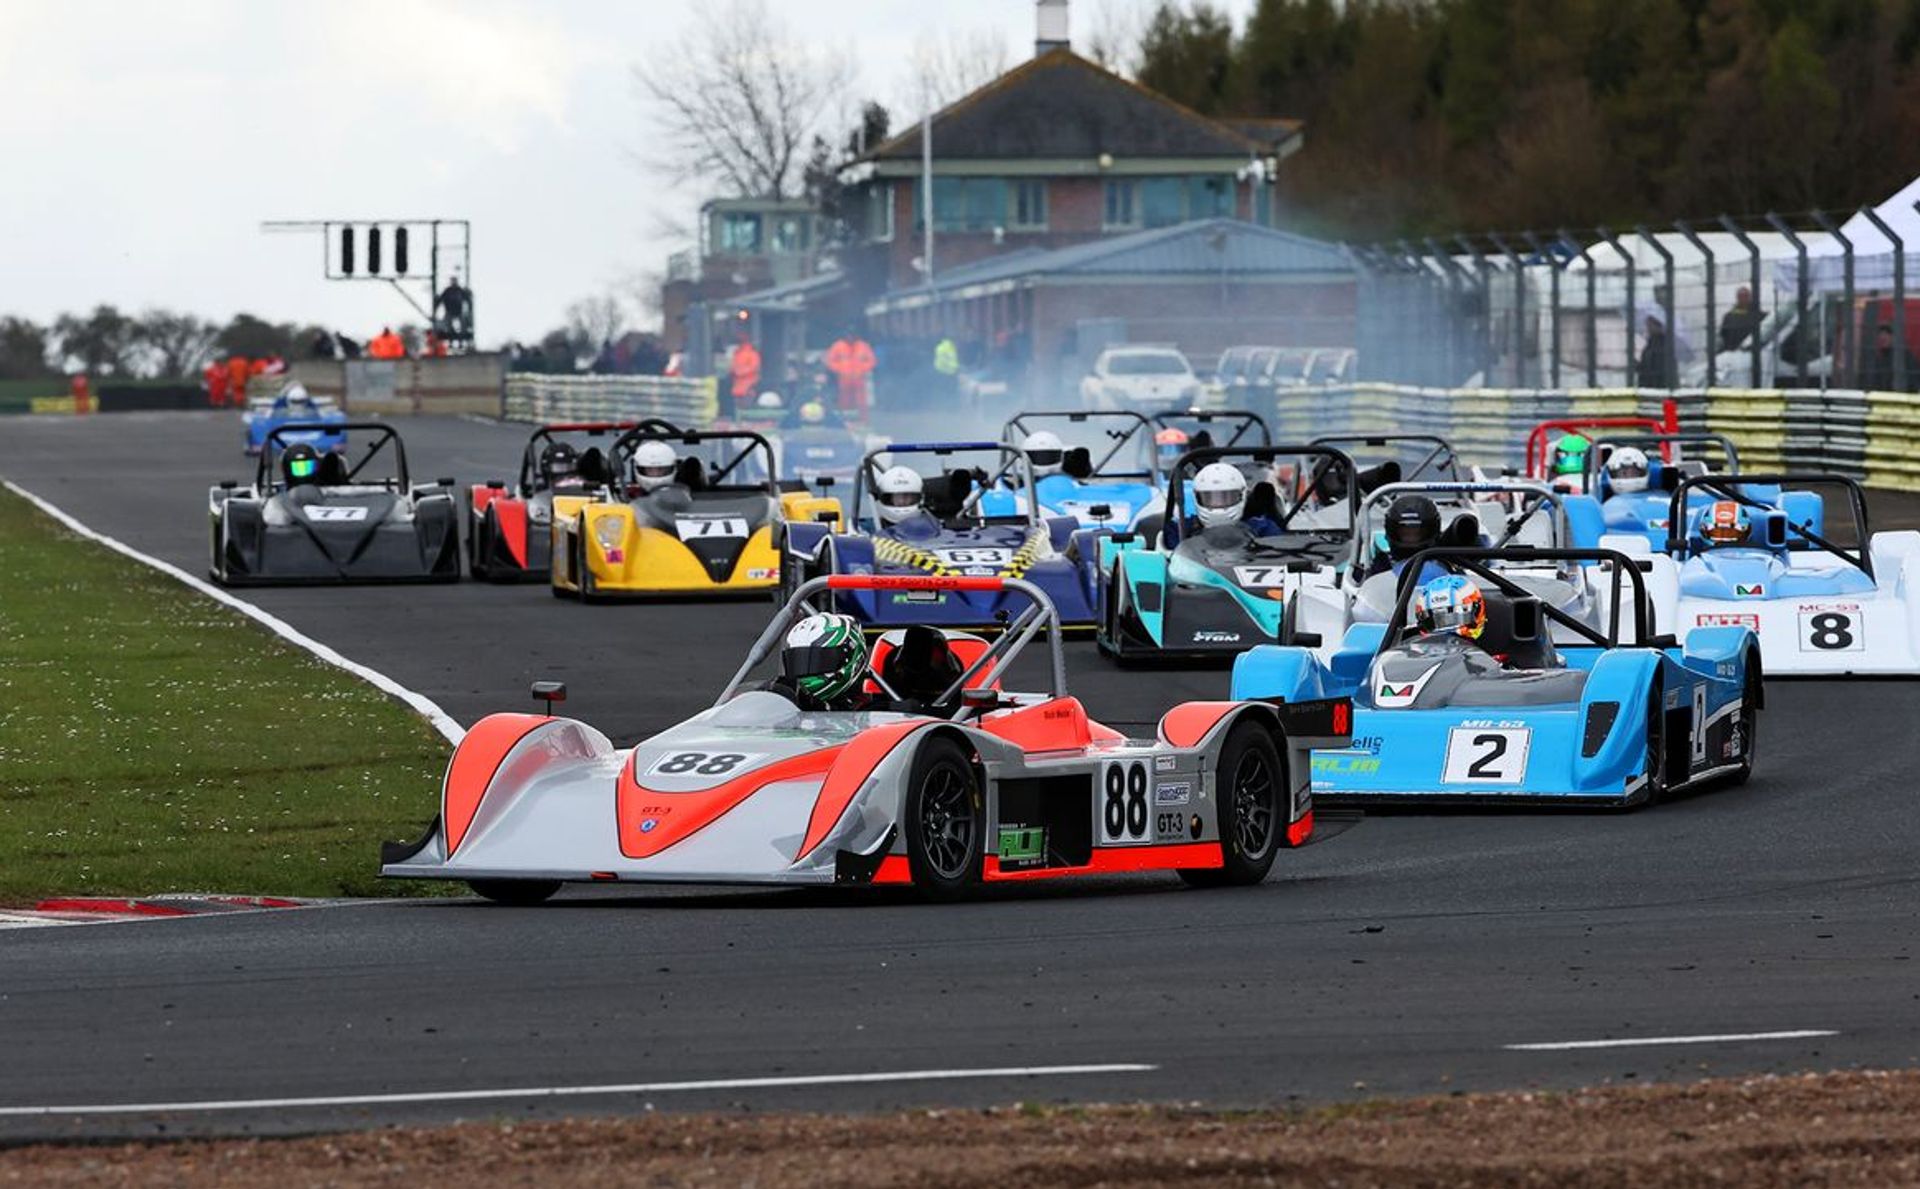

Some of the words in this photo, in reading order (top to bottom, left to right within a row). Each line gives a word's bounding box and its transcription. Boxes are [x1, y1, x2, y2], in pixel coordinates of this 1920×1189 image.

[316, 508, 359, 518] 77
[693, 520, 733, 535] 71
[948, 551, 1002, 563] 63
[1810, 612, 1853, 650] 8
[1333, 703, 1348, 736] 88
[657, 753, 747, 775] 88
[1467, 734, 1508, 778] 2
[642, 806, 672, 816] GT-3
[1105, 761, 1148, 839] 88
[1157, 812, 1184, 834] GT-3
